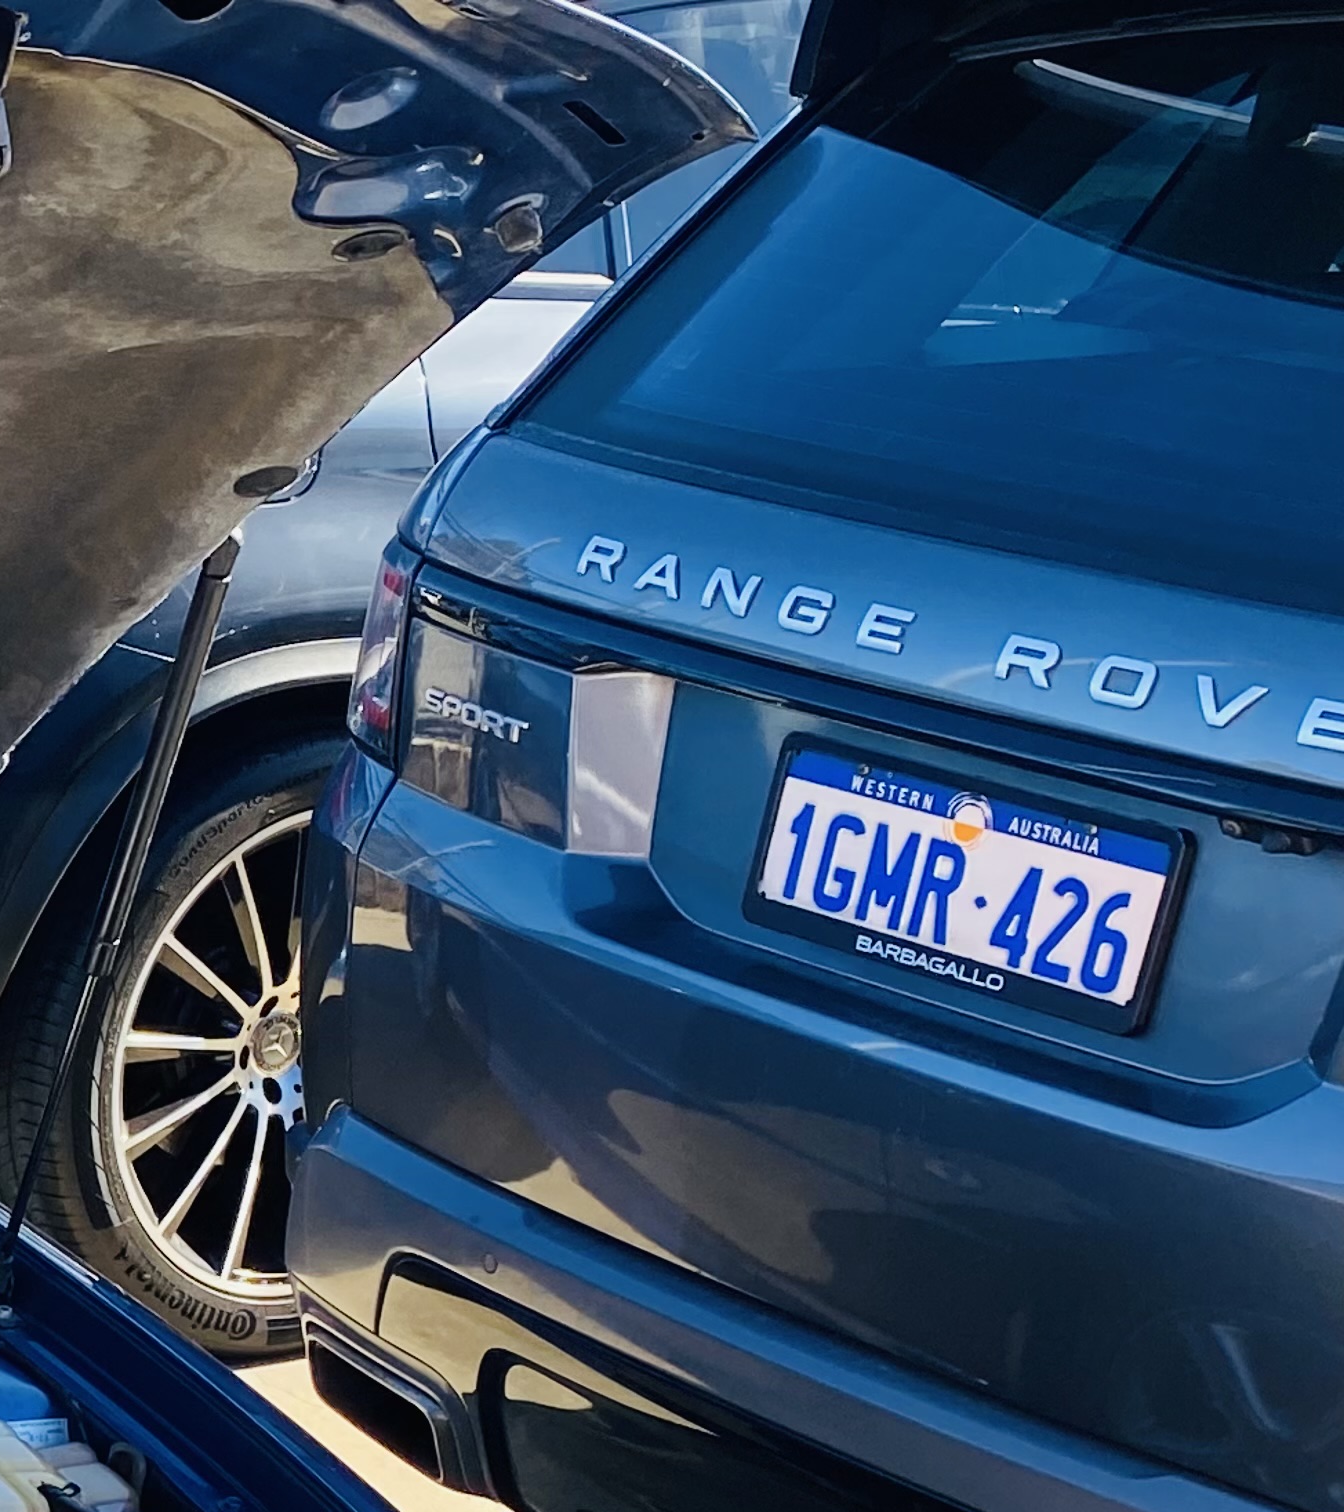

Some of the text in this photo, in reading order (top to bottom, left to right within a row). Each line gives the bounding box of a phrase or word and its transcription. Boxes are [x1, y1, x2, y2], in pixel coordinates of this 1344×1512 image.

[577, 534, 916, 654] RANGE
[425, 687, 529, 743] SPORT
[851, 775, 1101, 856] WESTERN AUSTRALIA
[855, 934, 1005, 992] BARBAGALLO
